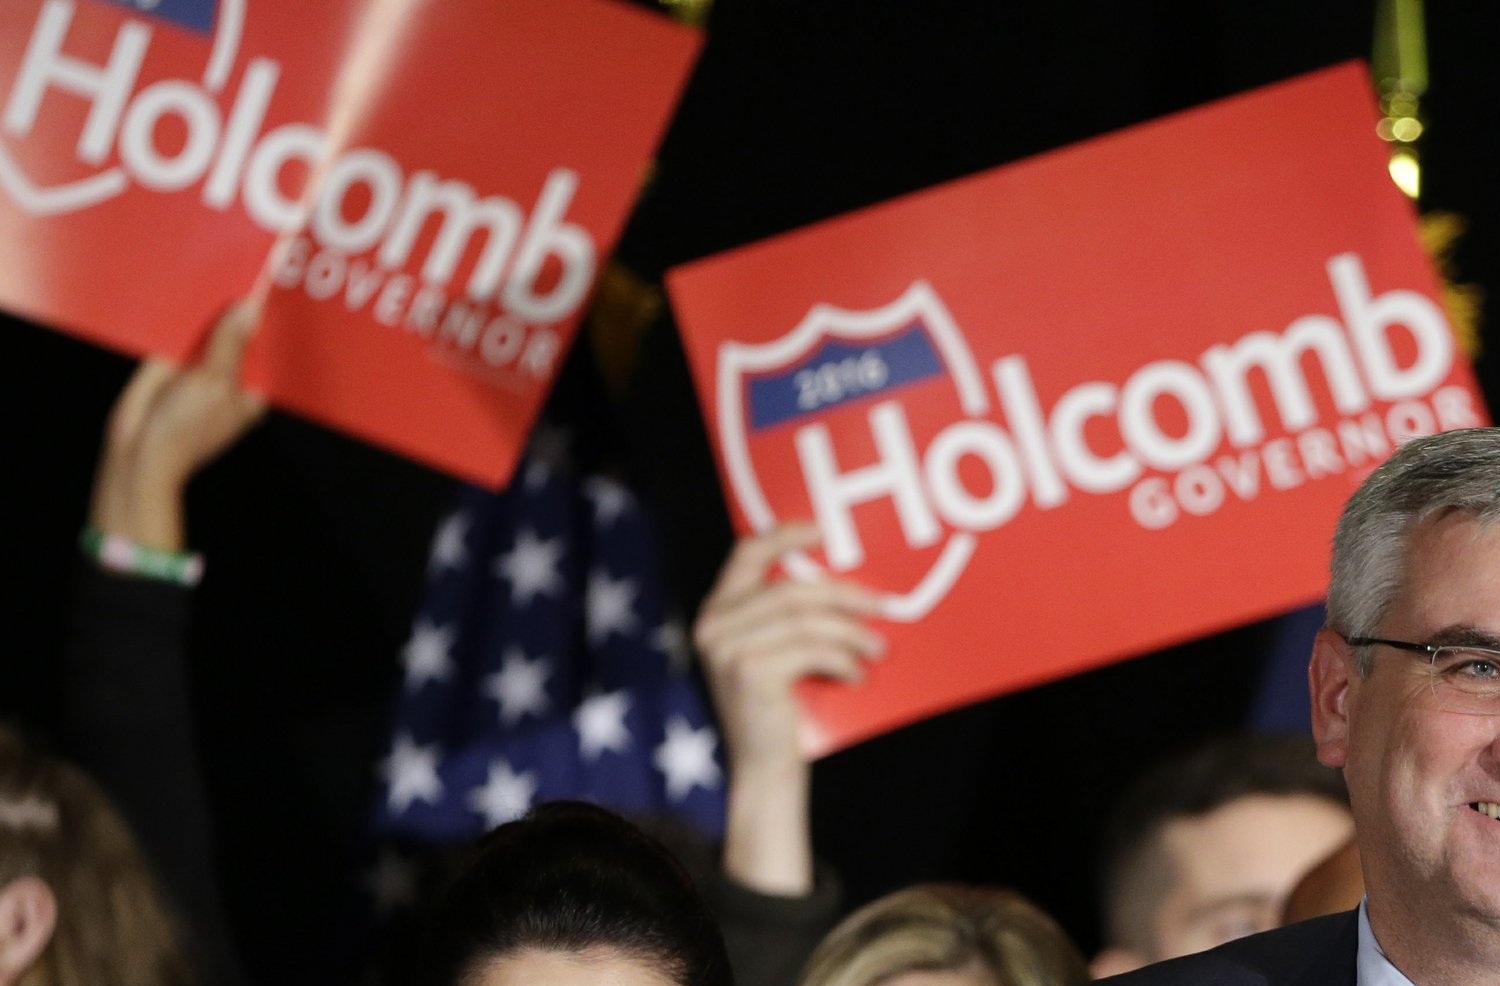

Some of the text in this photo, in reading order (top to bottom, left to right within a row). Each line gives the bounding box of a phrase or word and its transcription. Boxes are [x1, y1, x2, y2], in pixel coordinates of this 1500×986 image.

[4, 0, 599, 325] Holcomb
[272, 238, 561, 378] GOVERNOR
[795, 351, 888, 410] 2016
[795, 253, 1453, 571] Holcomb
[1129, 386, 1480, 530] GOVERNOR
